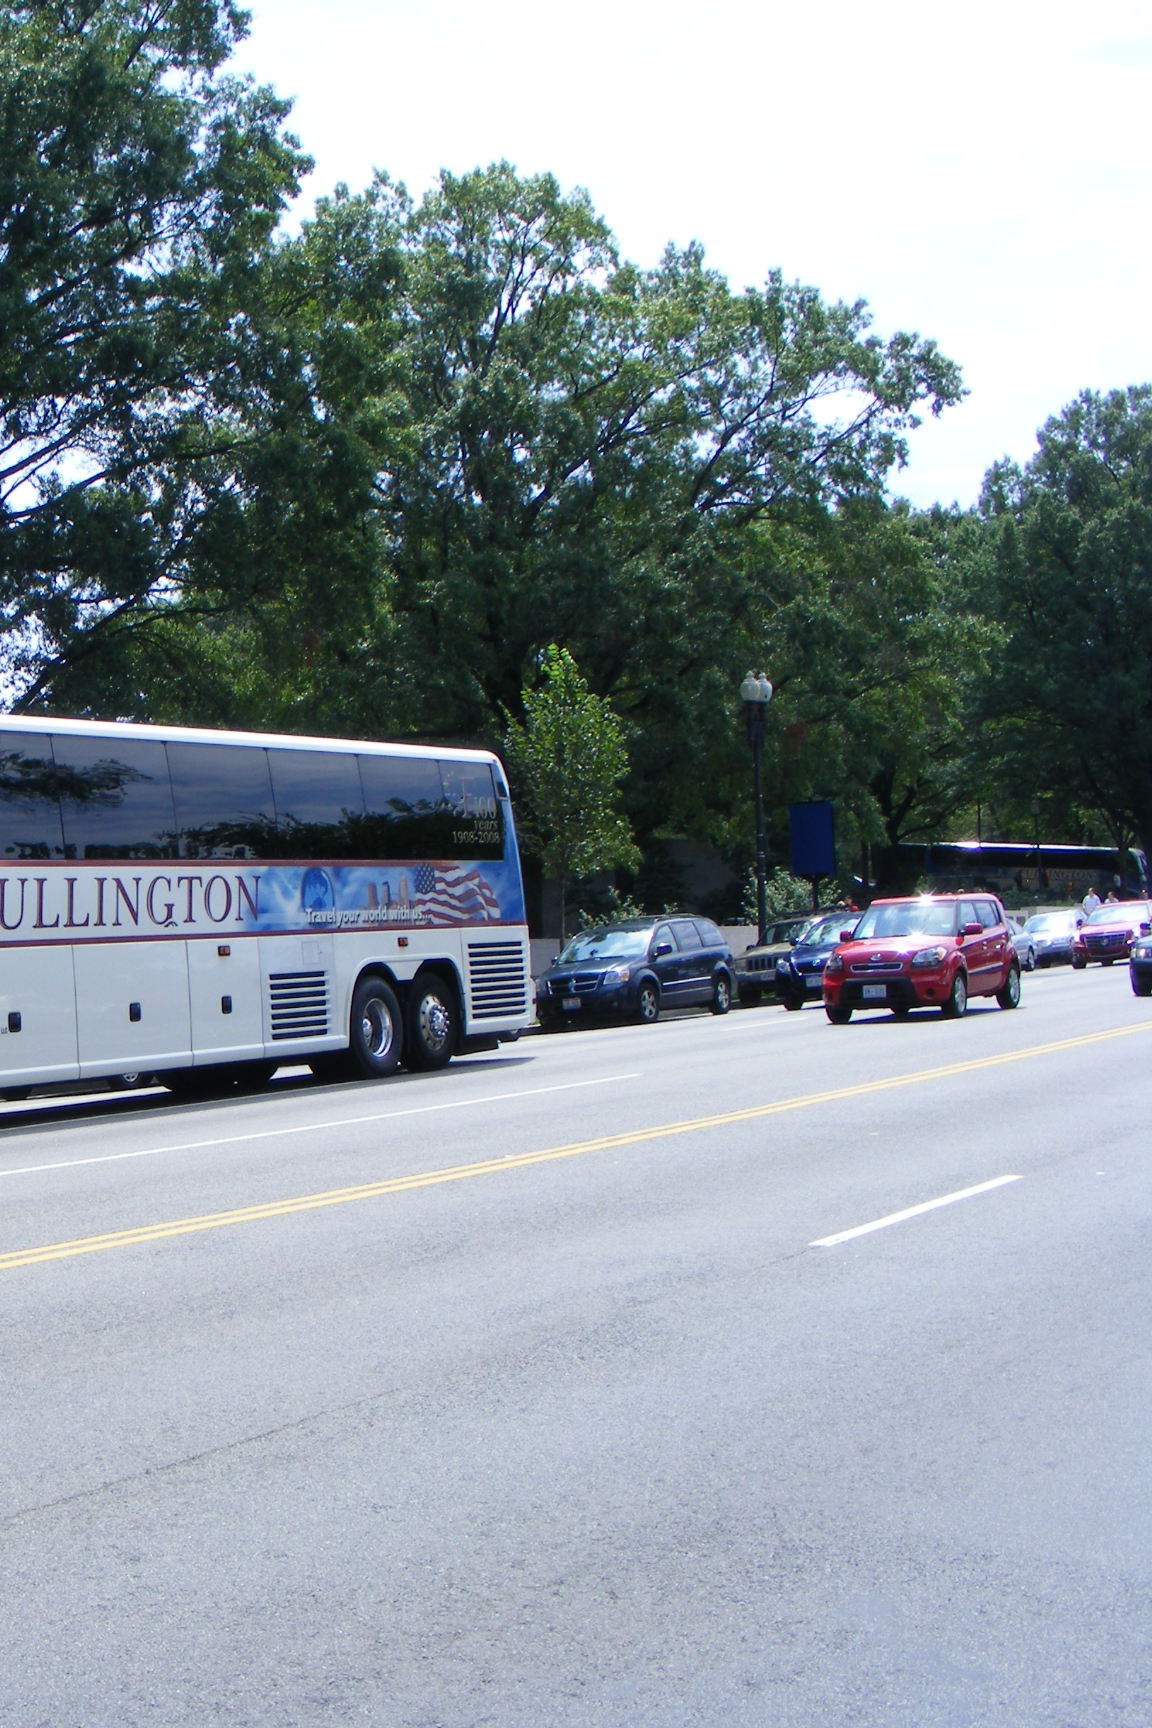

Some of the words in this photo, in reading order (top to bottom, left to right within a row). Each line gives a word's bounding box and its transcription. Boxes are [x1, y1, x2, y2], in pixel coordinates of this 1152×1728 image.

[452, 830, 501, 844] 1908-2008
[305, 907, 336, 924] Travel
[337, 911, 361, 927] your
[362, 905, 388, 923] world
[389, 905, 410, 922] with
